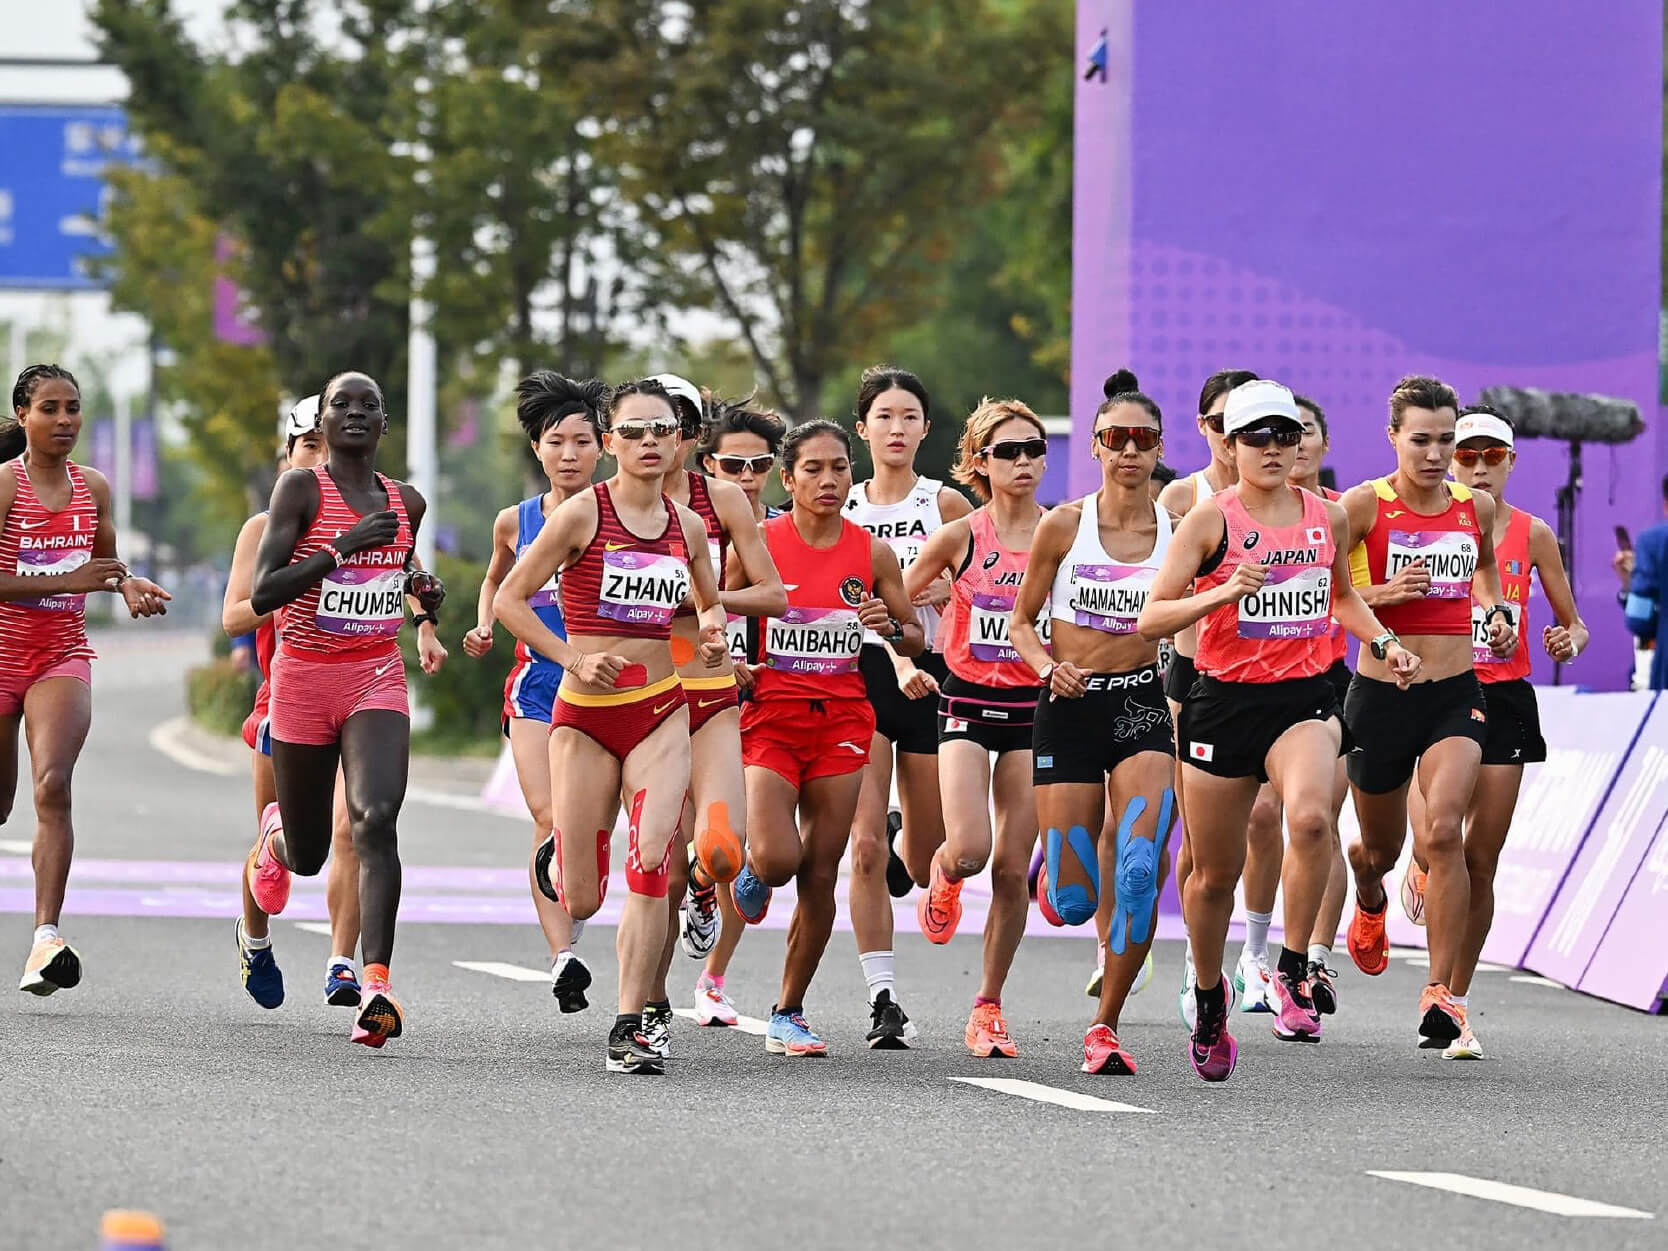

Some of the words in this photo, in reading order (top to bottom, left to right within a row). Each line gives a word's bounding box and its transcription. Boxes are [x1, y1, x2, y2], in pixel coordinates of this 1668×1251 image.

[20, 534, 88, 549] BAHRAIN
[1461, 544, 1472, 553] 68
[1261, 549, 1317, 565] JAPAN
[605, 575, 687, 604] ZHANG
[1318, 578, 1328, 588] 62
[324, 591, 402, 615] CHUMBA
[1244, 589, 1329, 617] OHNISHI
[847, 622, 858, 630] 58
[771, 628, 862, 654] NAIBAHO
[1107, 670, 1154, 690] PRO
